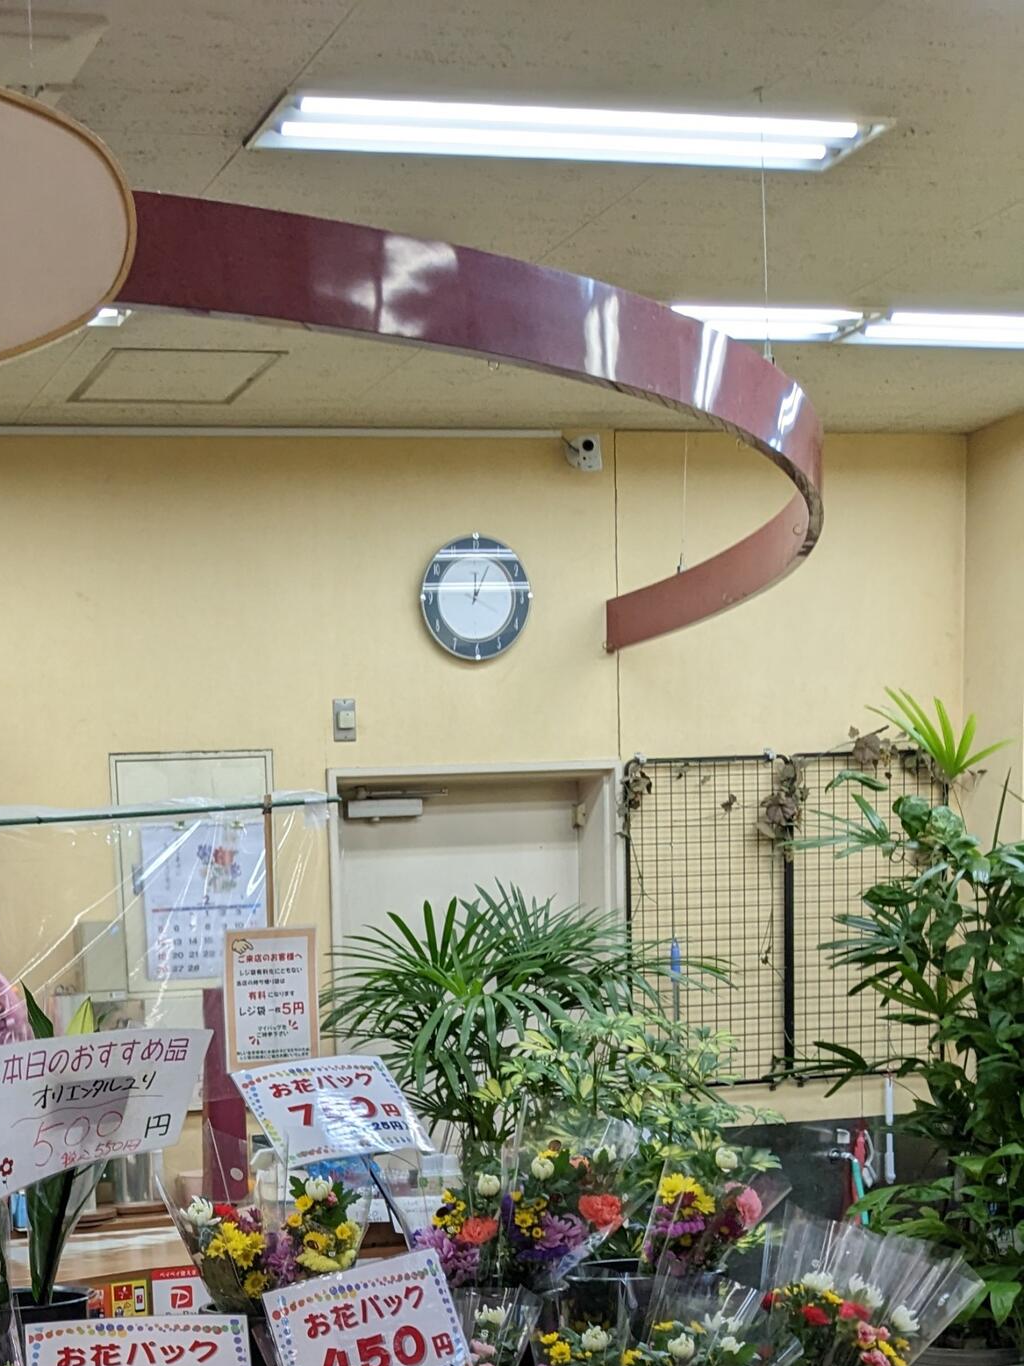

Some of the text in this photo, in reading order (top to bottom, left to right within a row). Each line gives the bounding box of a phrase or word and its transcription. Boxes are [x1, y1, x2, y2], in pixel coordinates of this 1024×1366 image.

[238, 952, 303, 964] ご来店のお客様へ
[2, 1037, 190, 1085] 本日のおすすめ品
[269, 1071, 373, 1099] お花パック
[303, 1284, 424, 1339] お花パック
